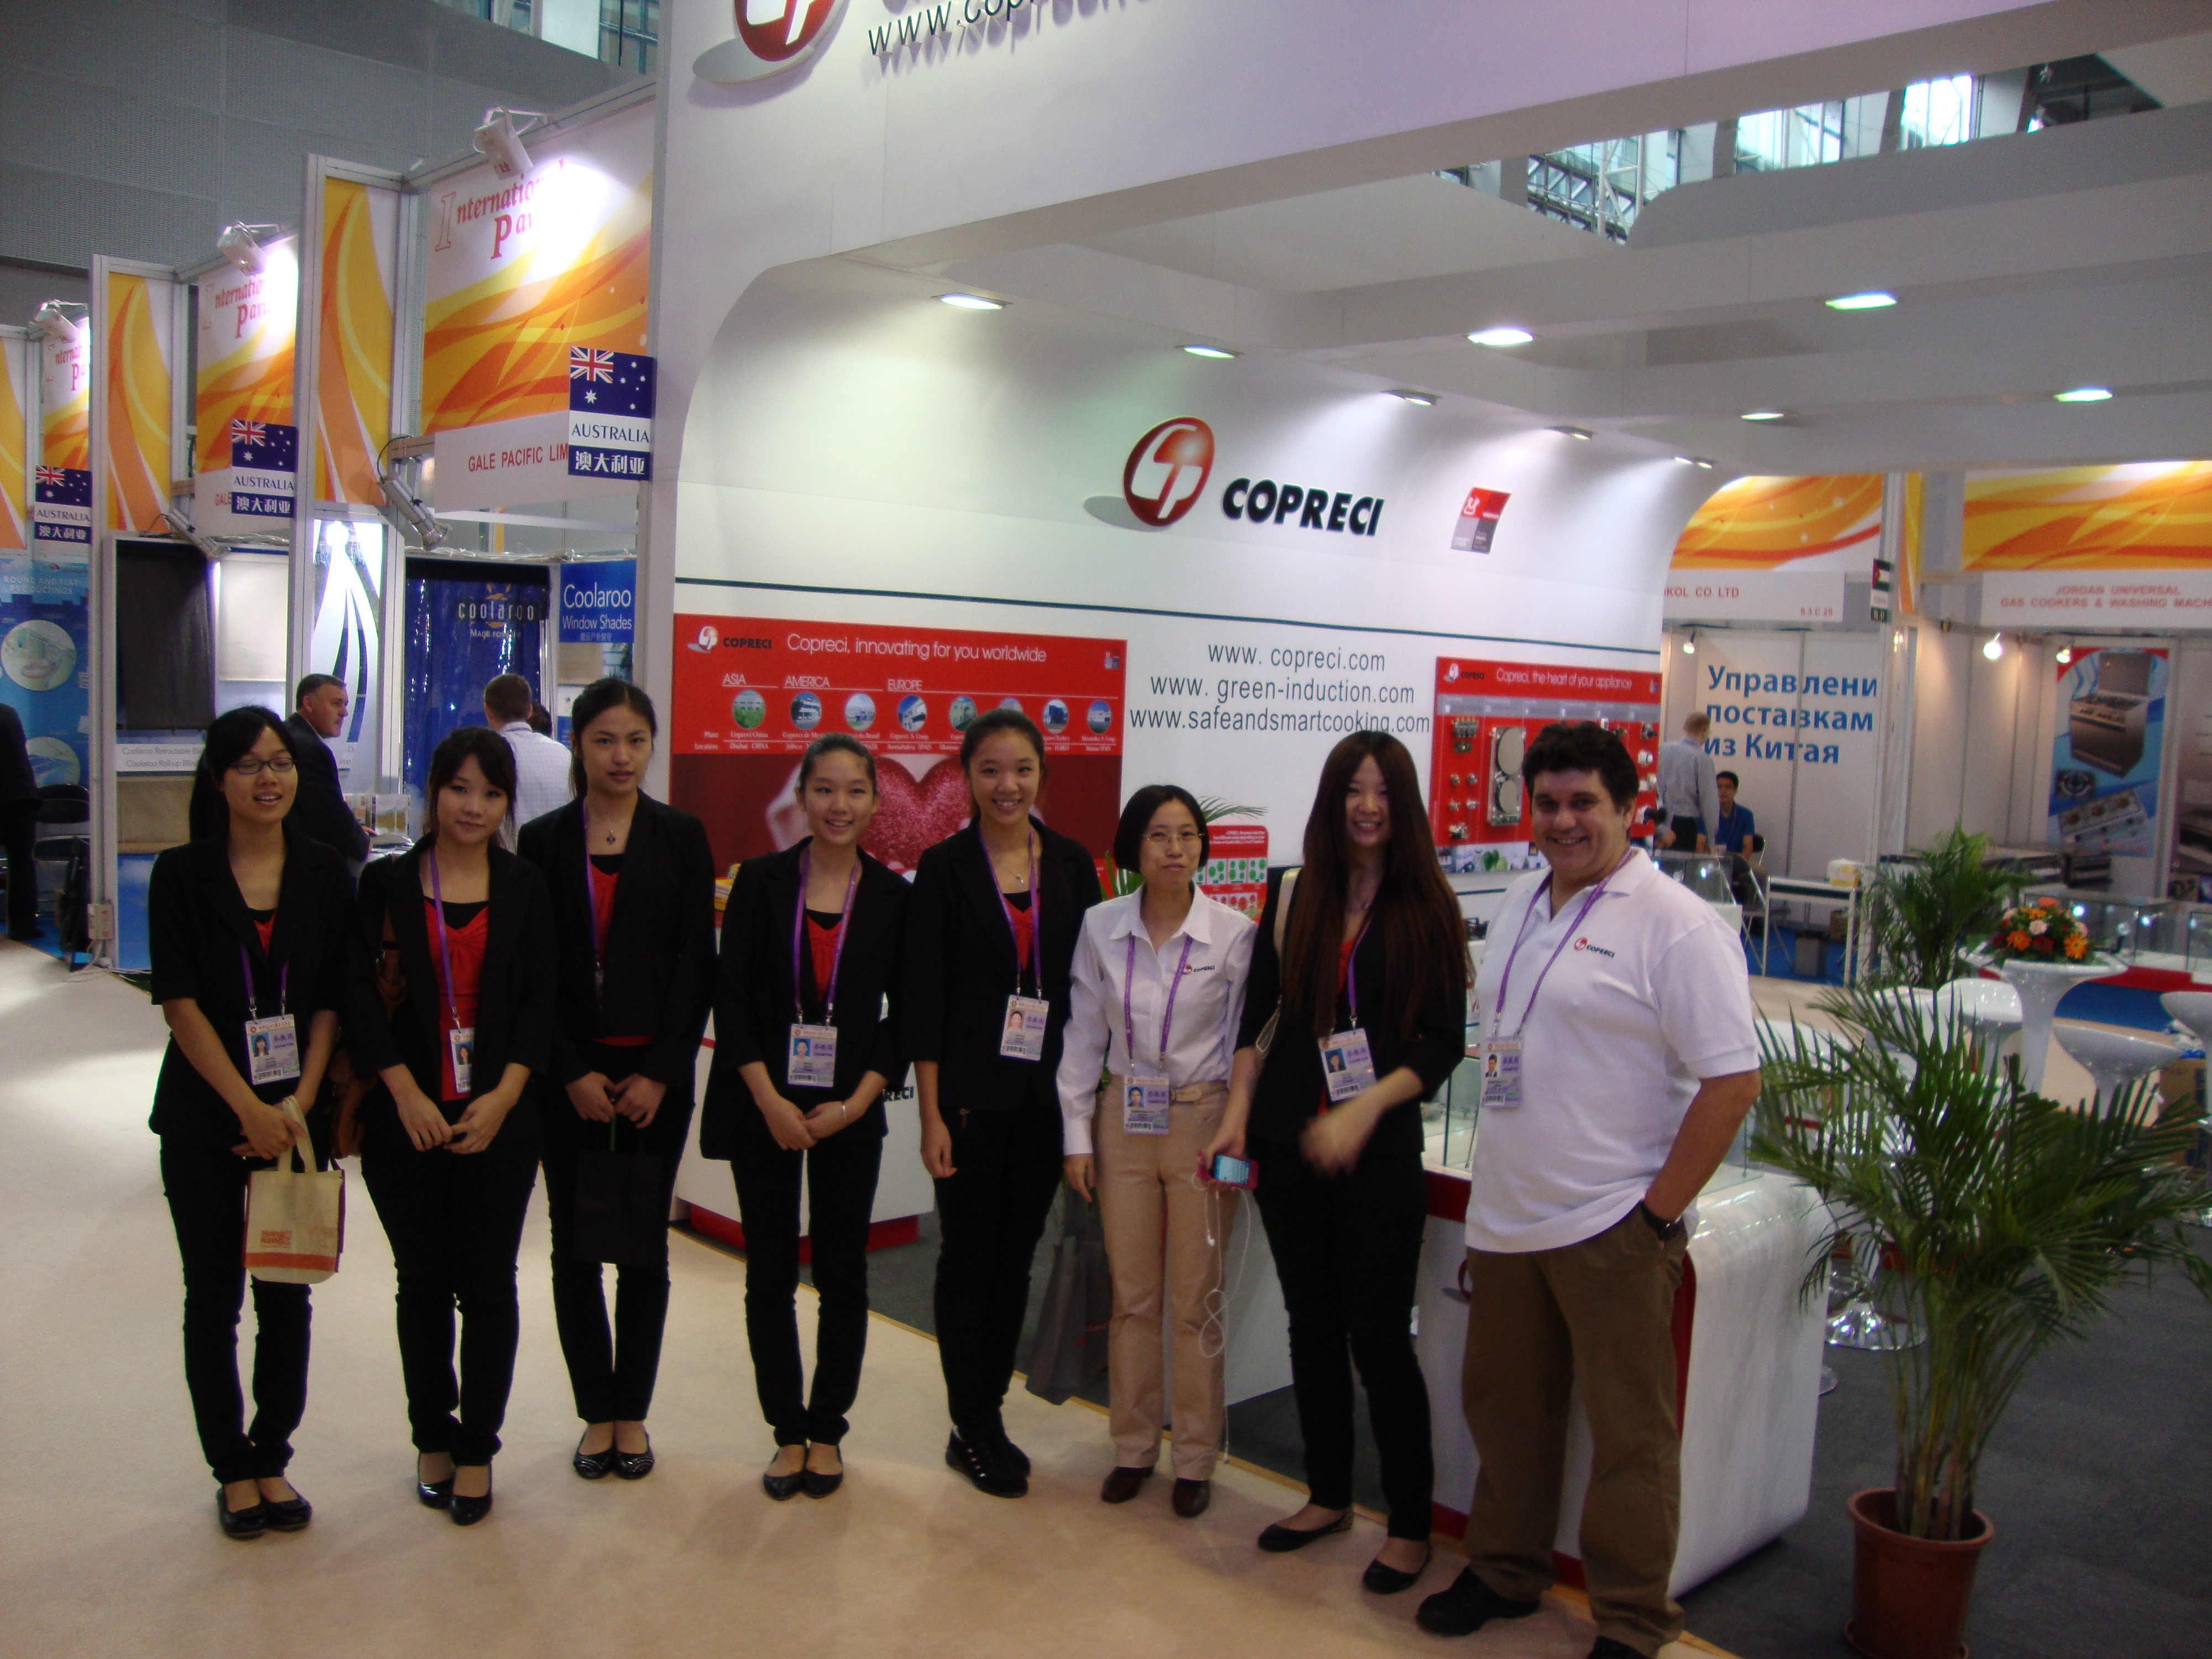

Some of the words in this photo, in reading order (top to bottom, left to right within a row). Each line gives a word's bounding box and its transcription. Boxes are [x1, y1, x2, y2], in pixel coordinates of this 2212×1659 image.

[868, 0, 1033, 56] www.cop
[571, 423, 649, 443] AUSTRALIA
[468, 454, 495, 472] GALE
[502, 446, 543, 466] PACIFIC
[575, 450, 645, 476] 澳大利亚
[233, 476, 294, 491] AUSTRALIA
[236, 496, 291, 514] 澳大利亚
[1222, 477, 1384, 537] COPRECI
[36, 509, 90, 522] AUSTRALIA
[39, 525, 87, 540] 澳大利亚
[564, 582, 632, 608] Coolaroo
[1695, 587, 1712, 597] CO
[1718, 587, 1739, 597] LTD
[458, 601, 534, 620] coolaroo
[562, 615, 597, 629] Window
[600, 614, 632, 630] Shades
[723, 637, 772, 649] COPRECI
[855, 637, 930, 660] innovating
[933, 641, 950, 657] for
[954, 646, 979, 662] you
[982, 645, 1047, 663] worldwide
[1271, 647, 1385, 672] copreci.com
[723, 673, 747, 686] ASIA
[785, 675, 831, 688] AMERICA
[888, 679, 922, 691] EUROPE
[1460, 671, 1485, 680] COPRECI
[1533, 670, 1546, 684] the
[1548, 671, 1567, 685] heart
[1568, 672, 1577, 685] of
[1577, 676, 1594, 688] your
[1595, 676, 1632, 690] appliance
[1708, 665, 1877, 697] Управлени
[1217, 678, 1415, 705] green-induction.com
[1130, 706, 1430, 734] www.safeandsmartcooking.com
[1707, 703, 1874, 732] поставкам
[1704, 737, 1736, 757] из
[1746, 734, 1840, 764] Китая
[1587, 944, 1615, 958] COPRECI
